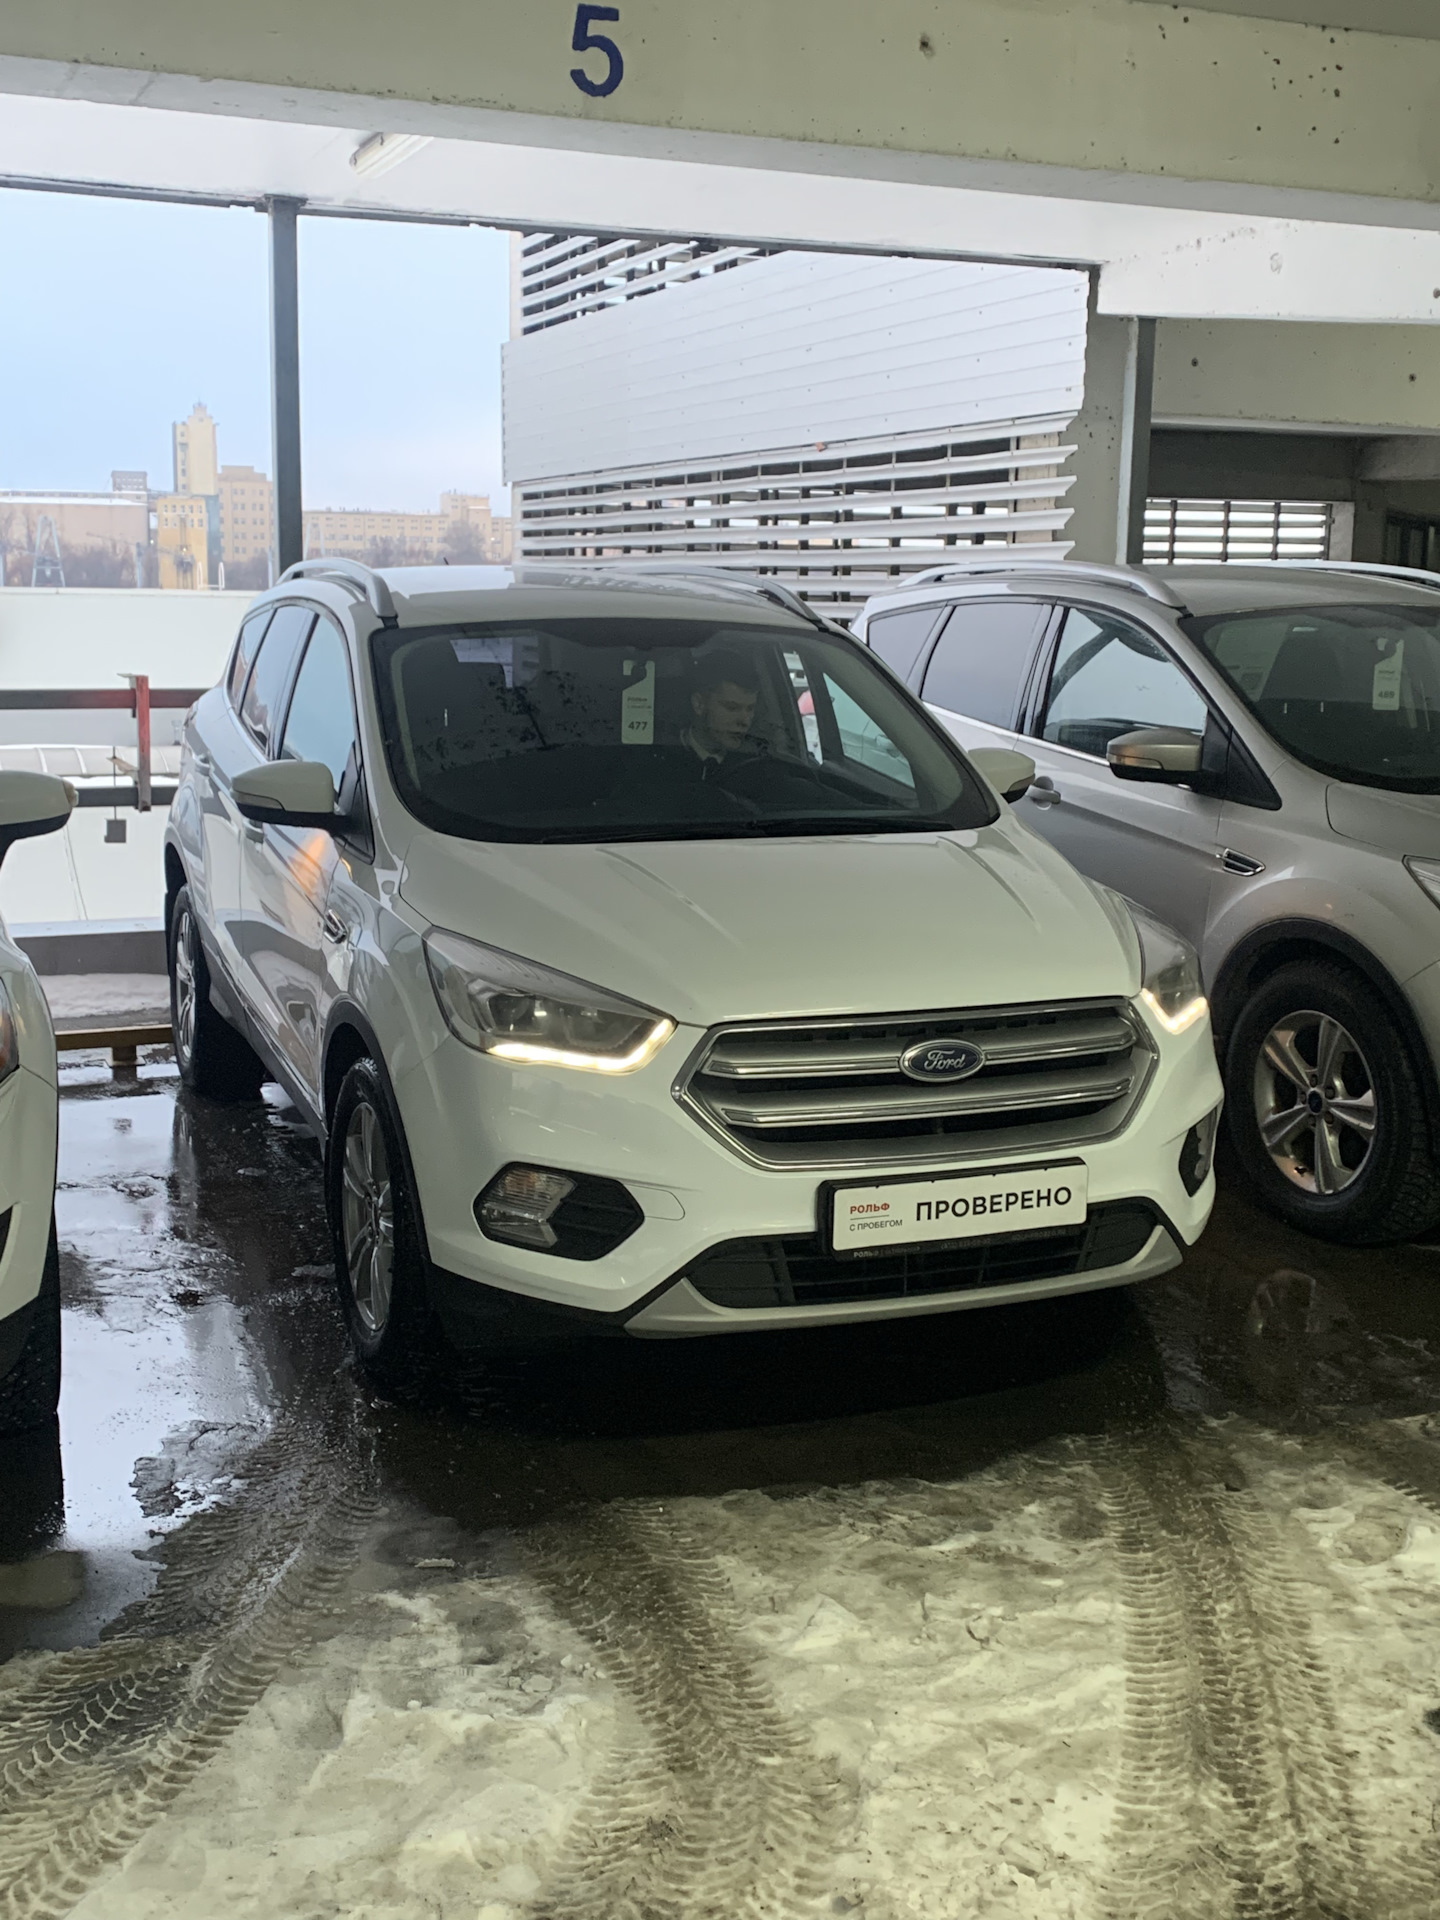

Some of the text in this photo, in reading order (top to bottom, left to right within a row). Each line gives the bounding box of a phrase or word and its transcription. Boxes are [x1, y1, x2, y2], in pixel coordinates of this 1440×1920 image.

[570, 3, 624, 98] 5
[628, 721, 648, 731] 477
[924, 1050, 966, 1071] Ford
[850, 1203, 890, 1214] РОЛЬФ
[916, 1186, 1072, 1221] ПРОВЕРЕНО
[849, 1219, 903, 1231] С ПРОБЕГОМ
